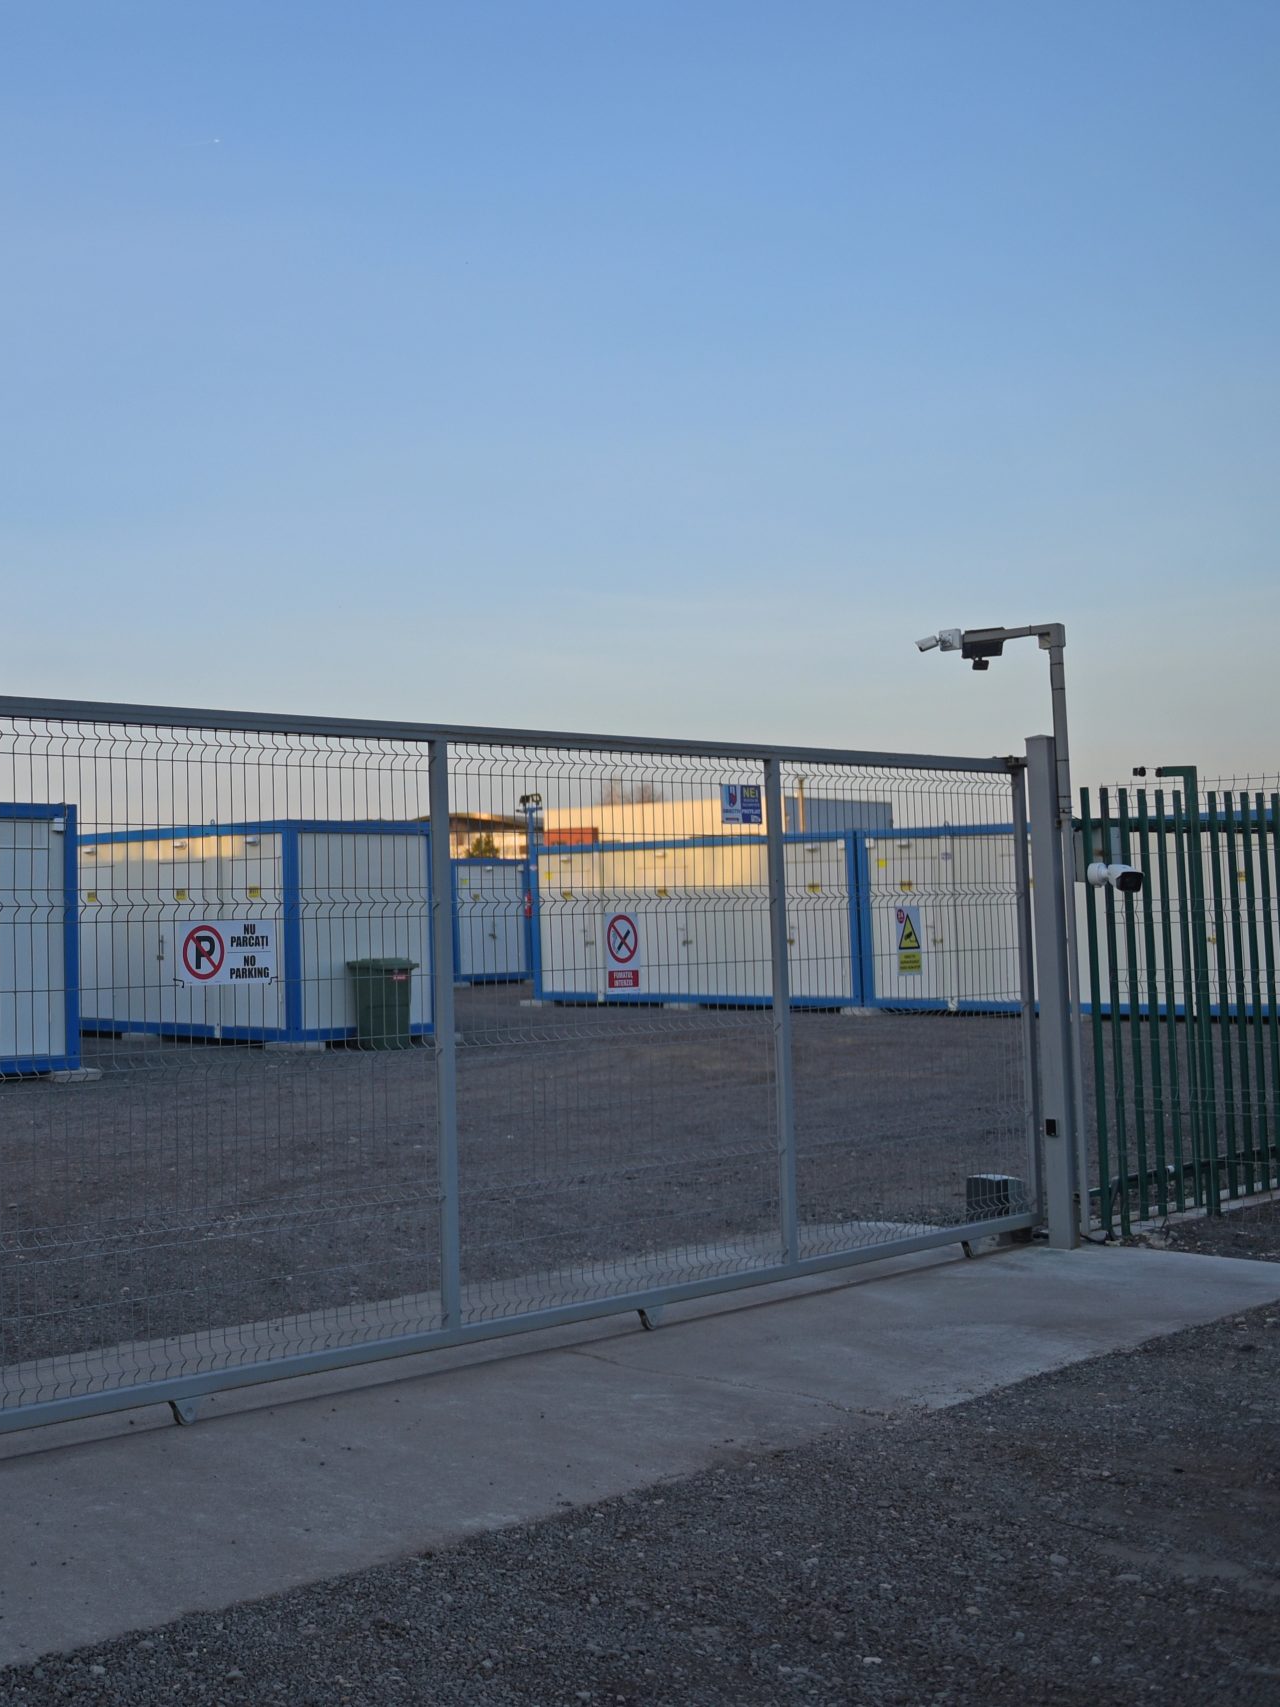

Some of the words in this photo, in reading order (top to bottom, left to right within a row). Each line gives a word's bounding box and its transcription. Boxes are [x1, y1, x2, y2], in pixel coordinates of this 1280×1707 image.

[243, 923, 256, 936] NU
[243, 954, 257, 967] NO
[229, 966, 270, 979] PARKING
